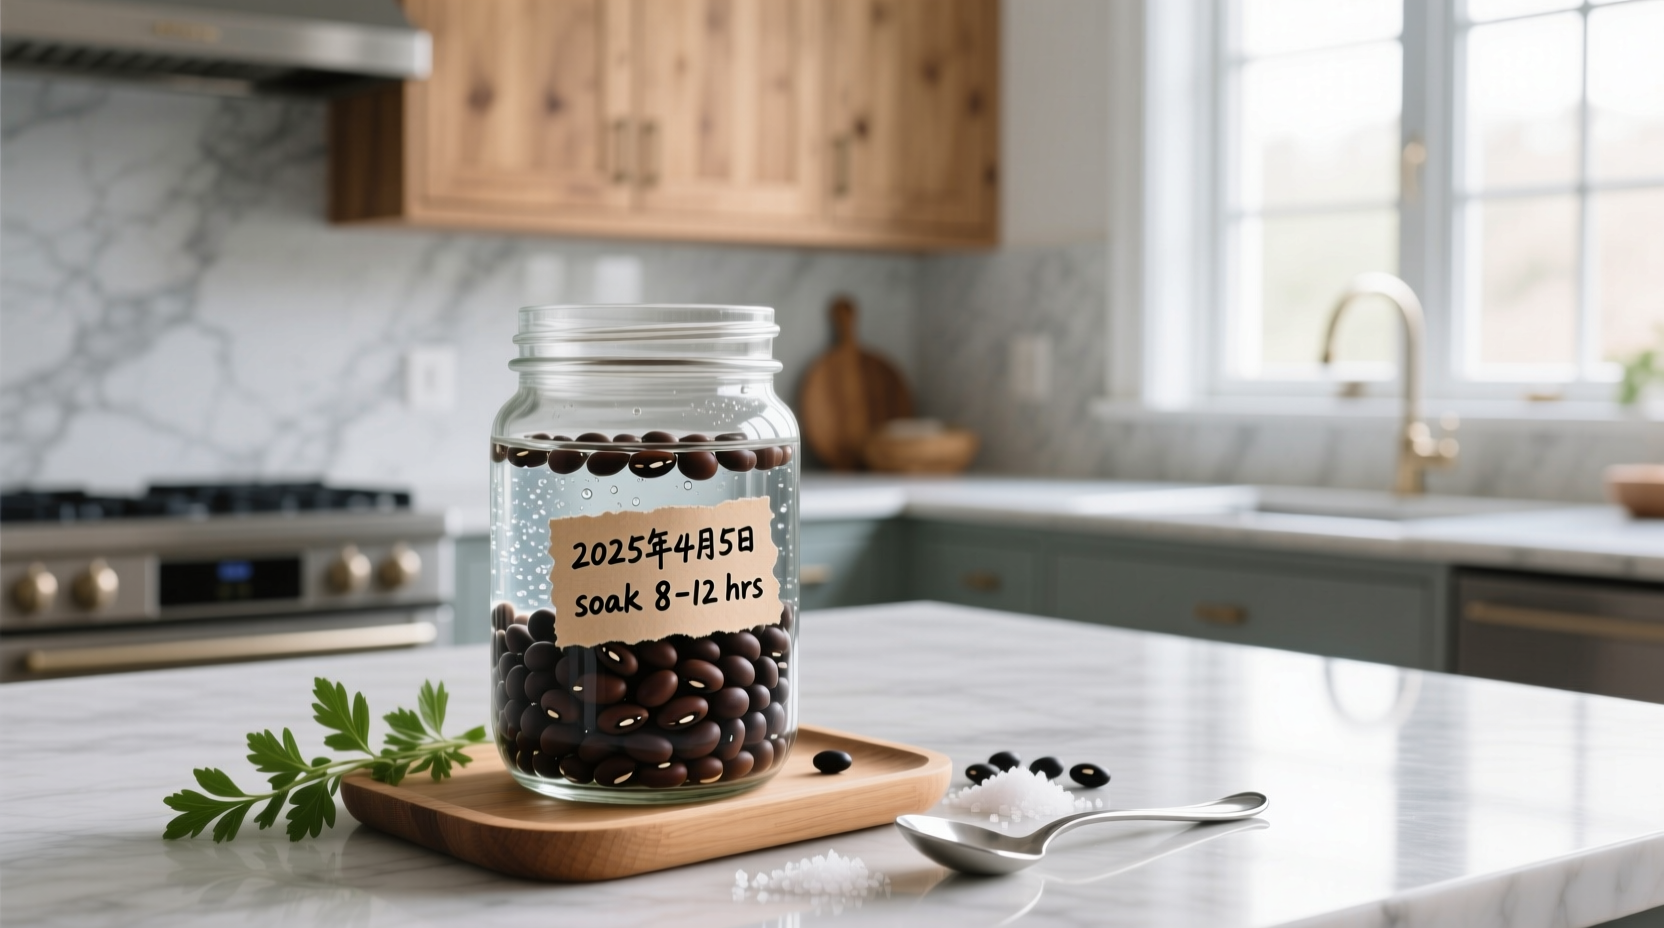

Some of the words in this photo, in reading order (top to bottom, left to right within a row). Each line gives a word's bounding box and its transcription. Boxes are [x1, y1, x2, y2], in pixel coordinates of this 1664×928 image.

[572, 525, 754, 570] 2025年4月5日
[575, 582, 643, 617] soak
[655, 579, 719, 612] 8-12
[725, 573, 764, 602] hrs
